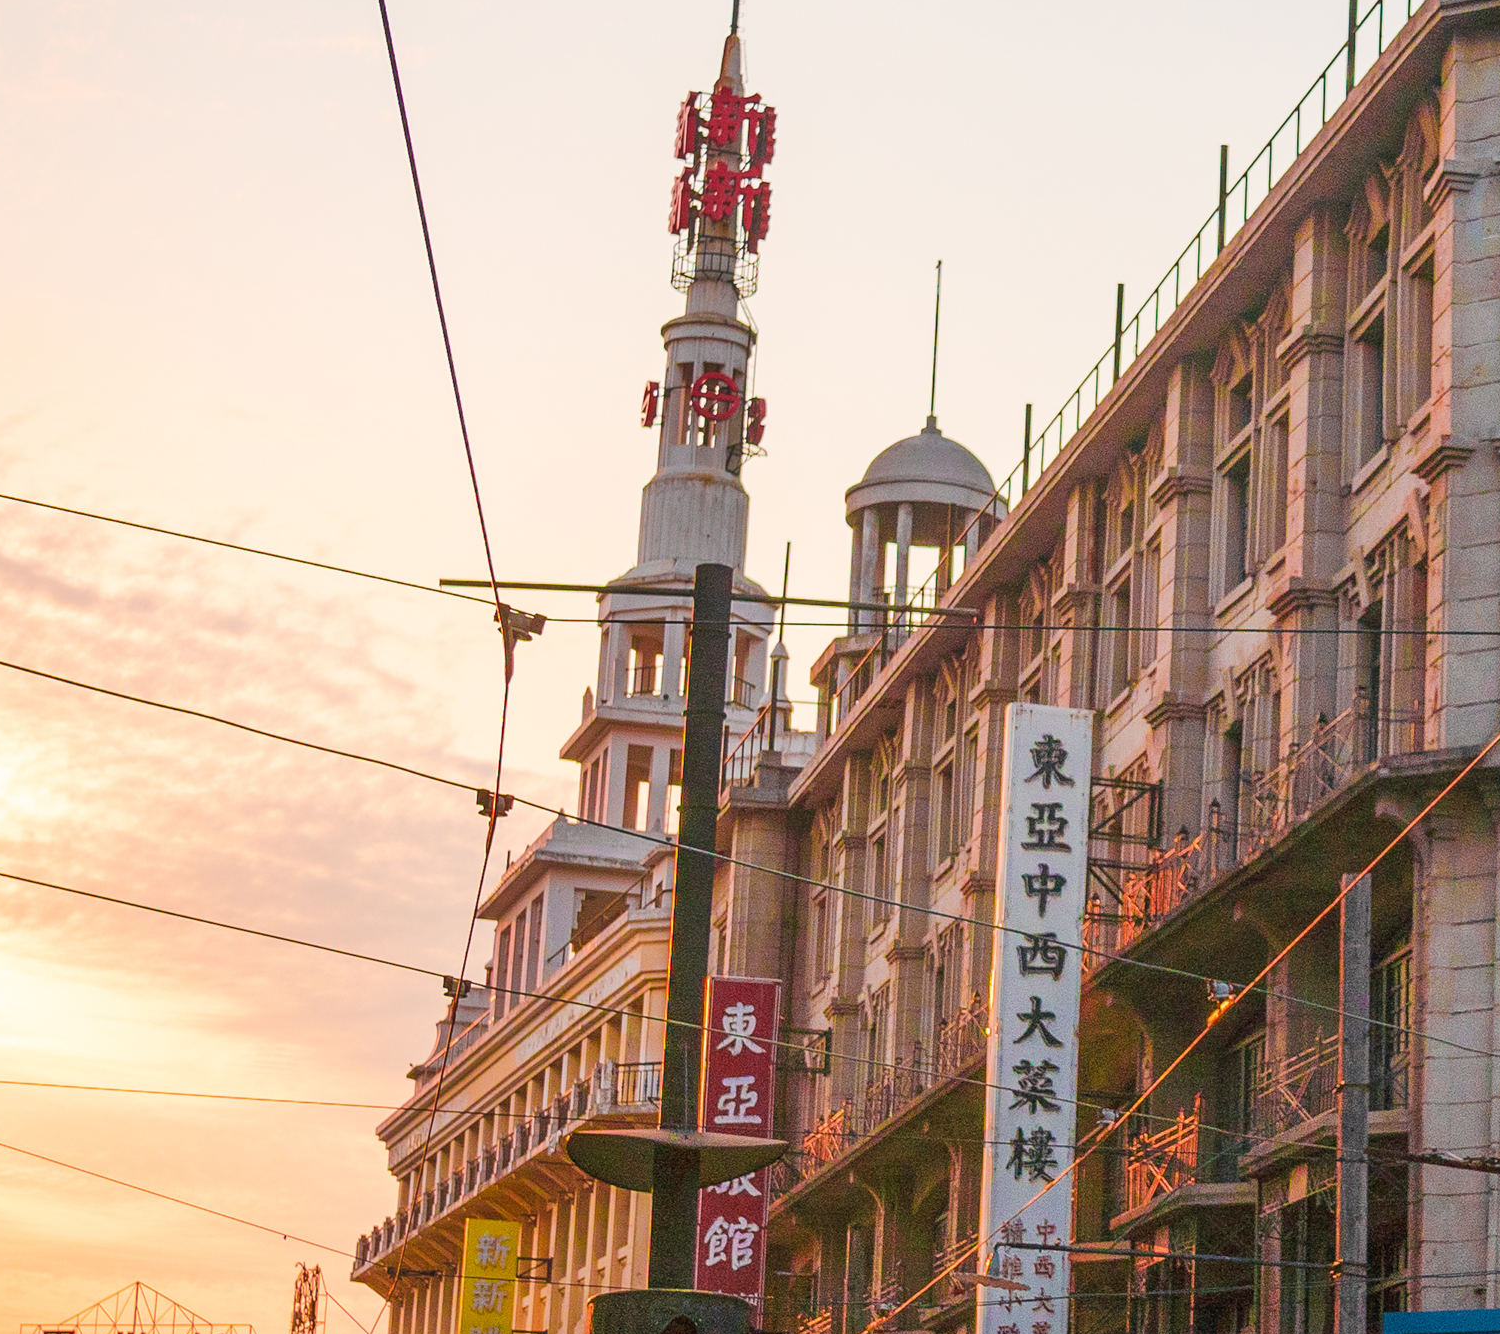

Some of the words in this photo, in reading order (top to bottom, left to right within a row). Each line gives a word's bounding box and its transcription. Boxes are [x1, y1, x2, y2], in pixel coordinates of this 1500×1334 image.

[1005, 734, 1075, 1183] 東亞中西大菜樓
